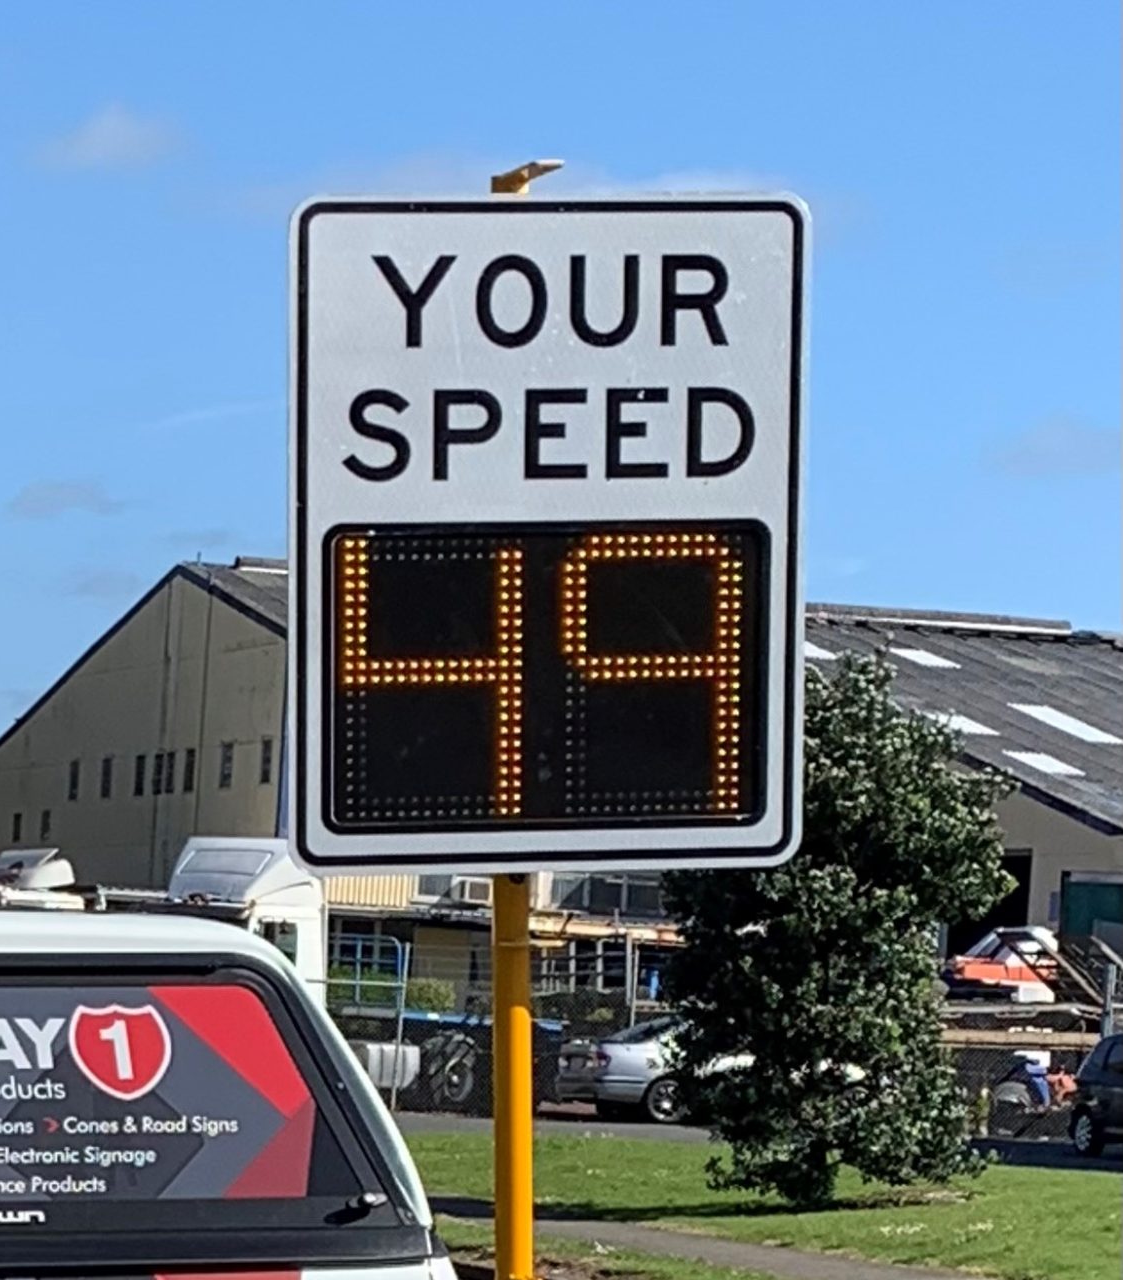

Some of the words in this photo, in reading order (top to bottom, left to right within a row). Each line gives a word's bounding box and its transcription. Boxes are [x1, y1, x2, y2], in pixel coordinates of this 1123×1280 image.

[370, 254, 729, 349] YOUR
[341, 387, 756, 482] SPEED
[344, 534, 743, 818] 49
[99, 1019, 134, 1081] 1
[63, 1115, 119, 1134] Cones
[123, 1115, 138, 1134] &
[142, 1114, 187, 1133] Road
[191, 1115, 239, 1136] Signs
[84, 1145, 157, 1167] Signage
[31, 1173, 107, 1194] Products
